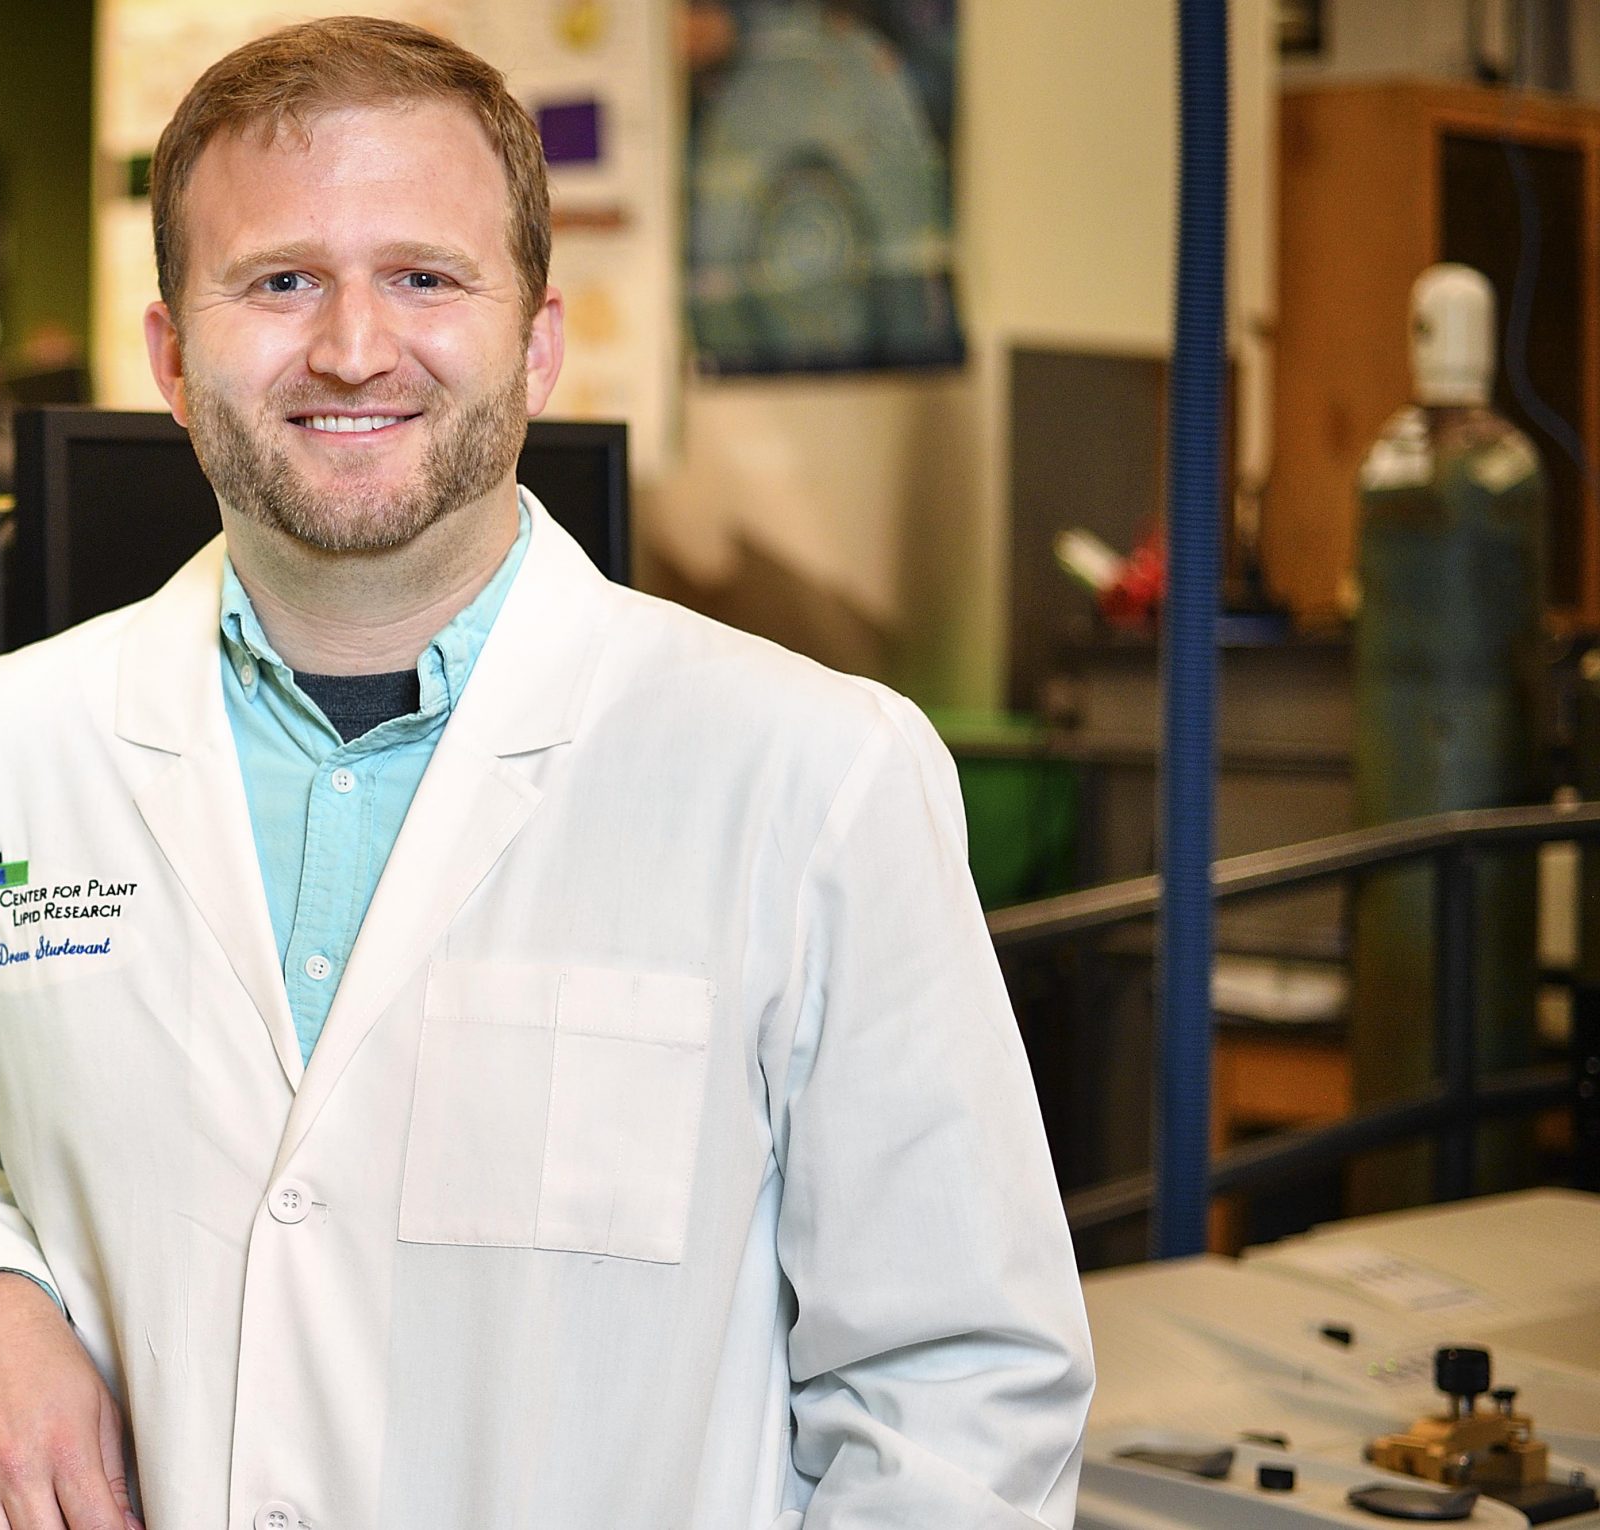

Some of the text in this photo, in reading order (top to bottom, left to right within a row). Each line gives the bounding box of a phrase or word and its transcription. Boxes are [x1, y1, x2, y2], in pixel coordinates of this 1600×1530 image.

[0, 879, 138, 908] CENTER FOR PLANT
[12, 902, 122, 927] LIPID RESEARCH
[35, 935, 111, 961] Sturtevant
